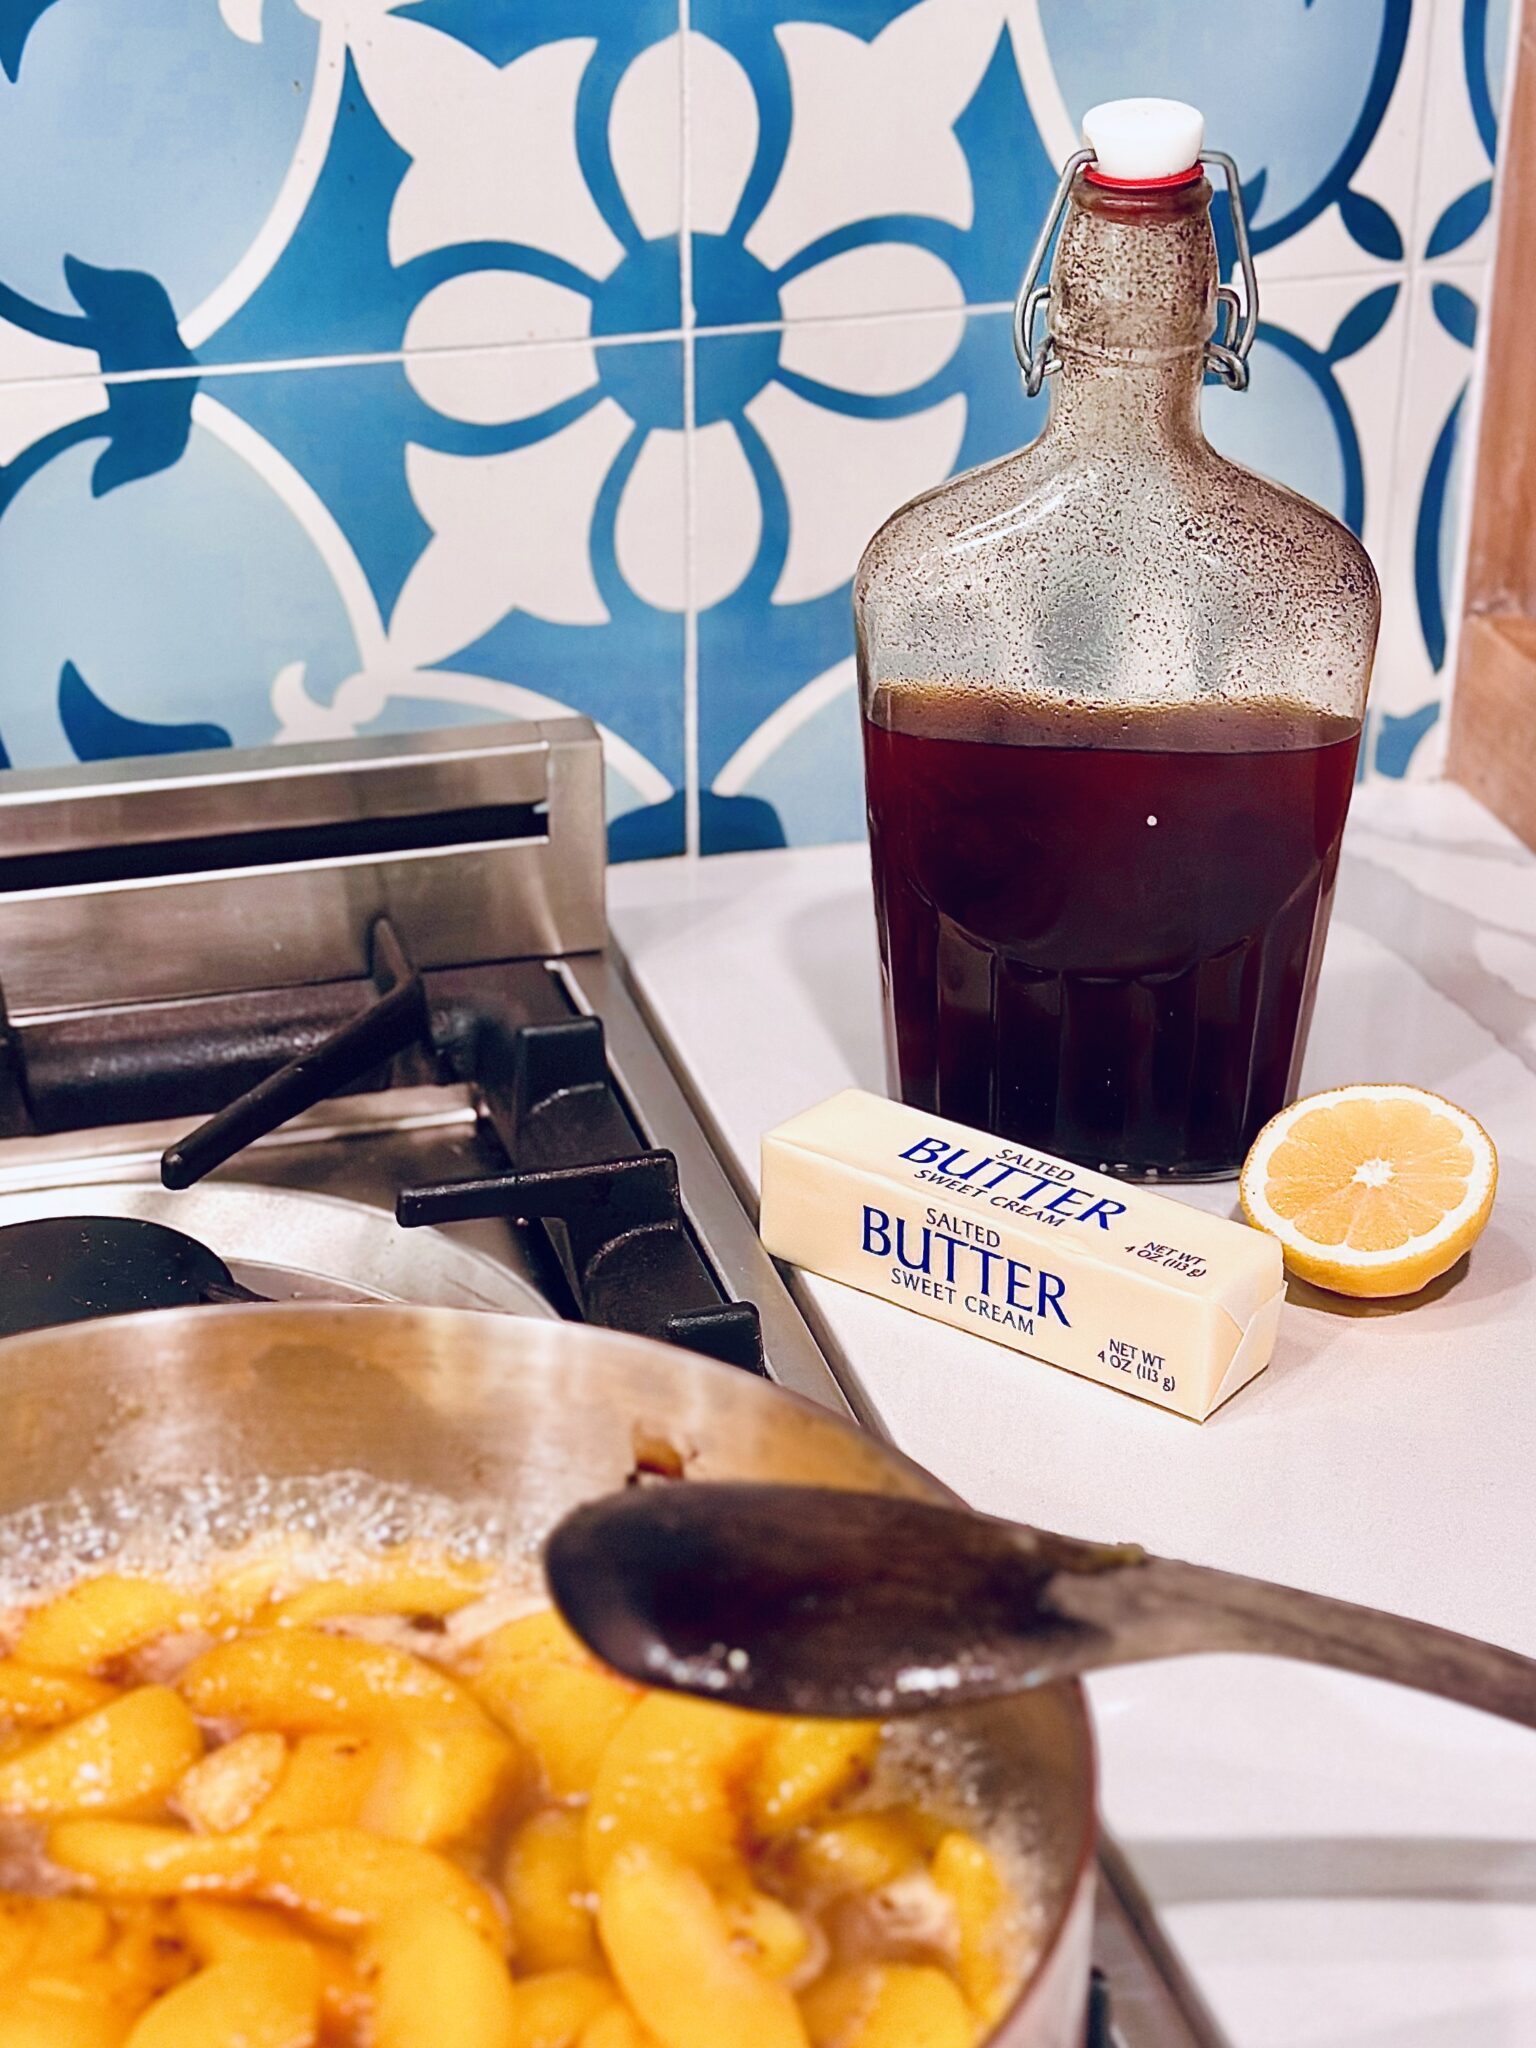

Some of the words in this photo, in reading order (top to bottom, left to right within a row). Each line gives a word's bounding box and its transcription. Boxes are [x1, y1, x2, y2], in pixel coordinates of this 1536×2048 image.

[898, 1136, 1128, 1230] BUTTER
[995, 1149, 1075, 1181] SALTED
[914, 1169, 987, 1198] SWEET
[990, 1196, 1066, 1227] CREAM
[926, 1207, 1000, 1248] SALTED
[862, 1205, 1072, 1327] BUTTER
[1124, 1245, 1135, 1253] 4
[1137, 1249, 1164, 1262] OZ
[1144, 1241, 1178, 1256] NET
[1178, 1253, 1206, 1265] WT
[891, 1267, 957, 1304] SWEET
[965, 1295, 1034, 1336] CREAM
[1097, 1350, 1105, 1363] 4
[1109, 1355, 1132, 1373] OZ
[1136, 1364, 1159, 1383] (113
[1162, 1376, 1176, 1392] g)
[1109, 1338, 1138, 1359] NET
[1141, 1350, 1166, 1370] WT
